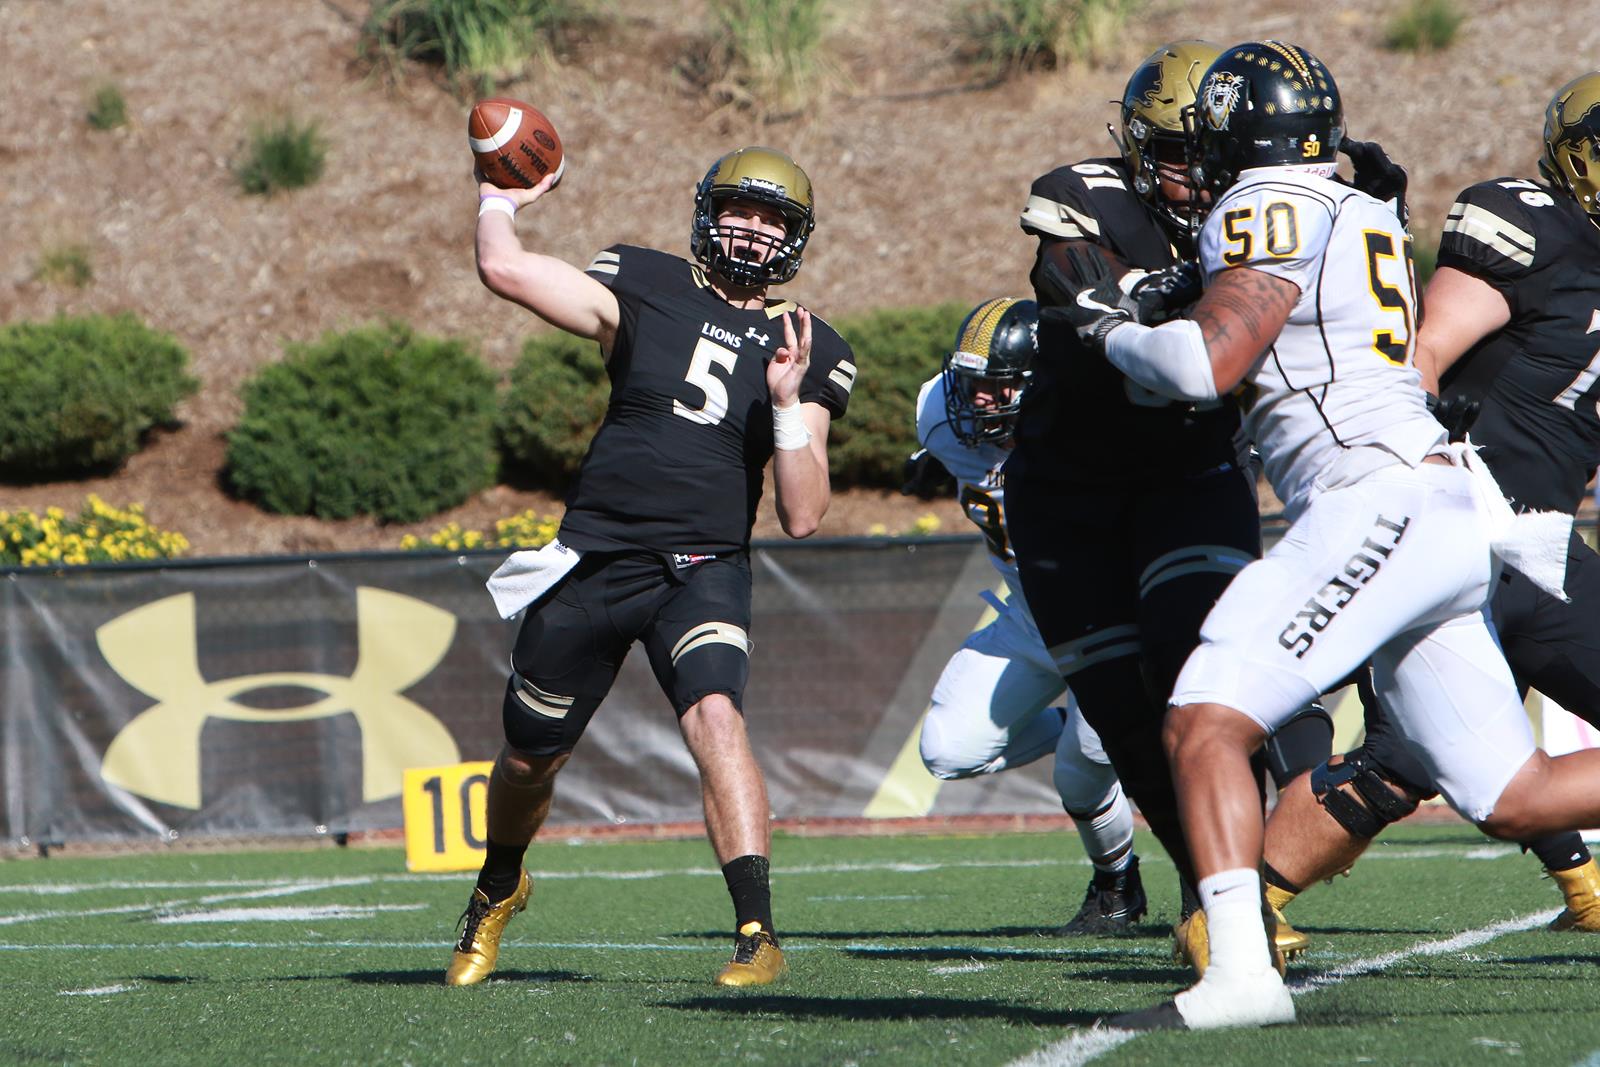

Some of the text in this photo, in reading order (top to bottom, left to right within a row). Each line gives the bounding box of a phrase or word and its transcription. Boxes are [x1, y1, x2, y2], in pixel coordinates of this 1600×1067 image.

[520, 143, 549, 177] Wilson
[1302, 140, 1321, 158] 50
[1497, 179, 1555, 208] 78
[1223, 201, 1300, 267] 50
[701, 321, 743, 348] LIONS
[673, 336, 738, 426] 5
[1278, 513, 1411, 659] TIGERS
[423, 773, 488, 854] 10
